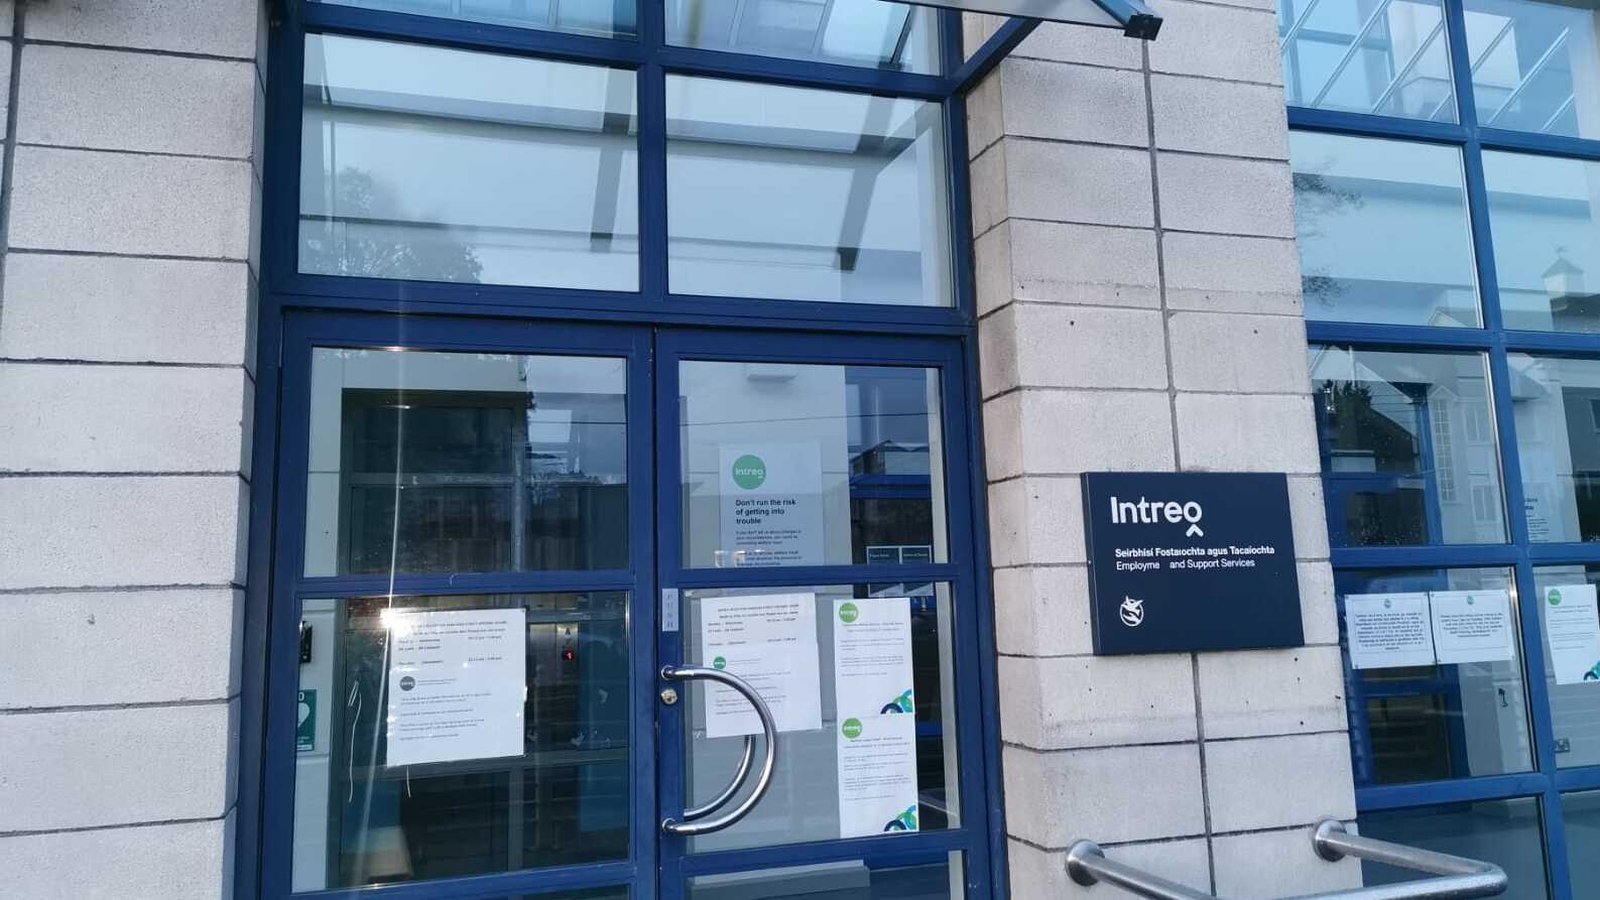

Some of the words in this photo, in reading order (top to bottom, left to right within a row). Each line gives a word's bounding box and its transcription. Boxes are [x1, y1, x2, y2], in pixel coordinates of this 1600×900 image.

[745, 508, 770, 516] getting
[1110, 496, 1203, 524] Intreo
[1207, 548, 1228, 557] agus
[1169, 560, 1185, 569] and
[1187, 558, 1219, 570] Support
[1220, 558, 1256, 567] Services
